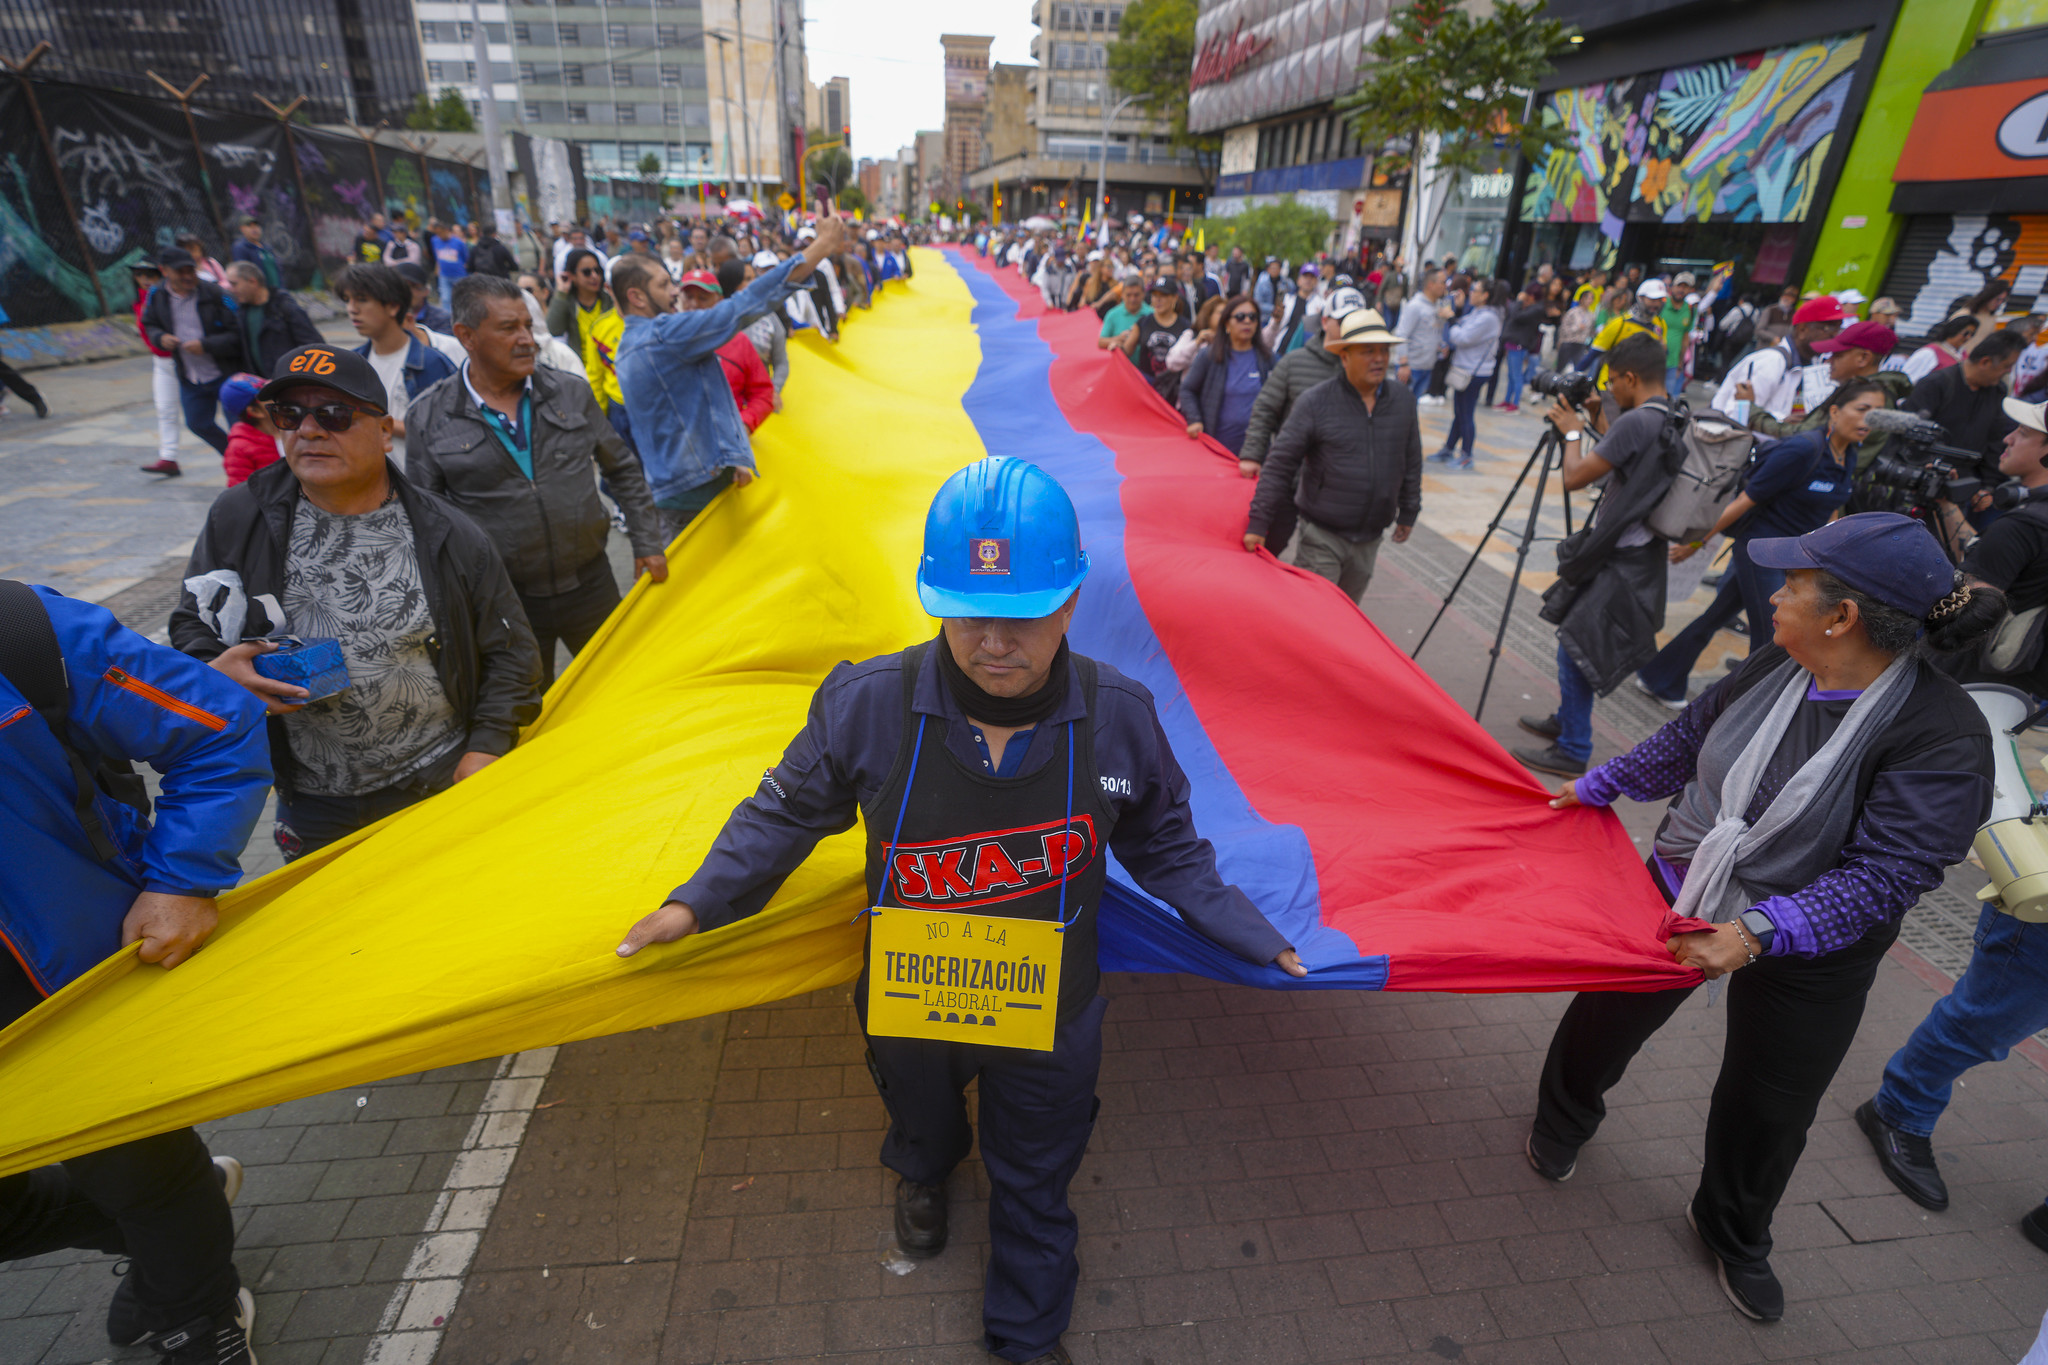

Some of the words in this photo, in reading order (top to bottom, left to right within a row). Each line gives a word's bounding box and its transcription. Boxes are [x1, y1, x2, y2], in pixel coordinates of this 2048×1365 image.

[893, 830, 1085, 899] SKA-P
[925, 921, 950, 940] NO
[961, 921, 973, 938] A
[984, 924, 1007, 947] LA
[885, 950, 1047, 995] TERCERIZACIÓN
[923, 989, 1003, 1013] LABORAL
